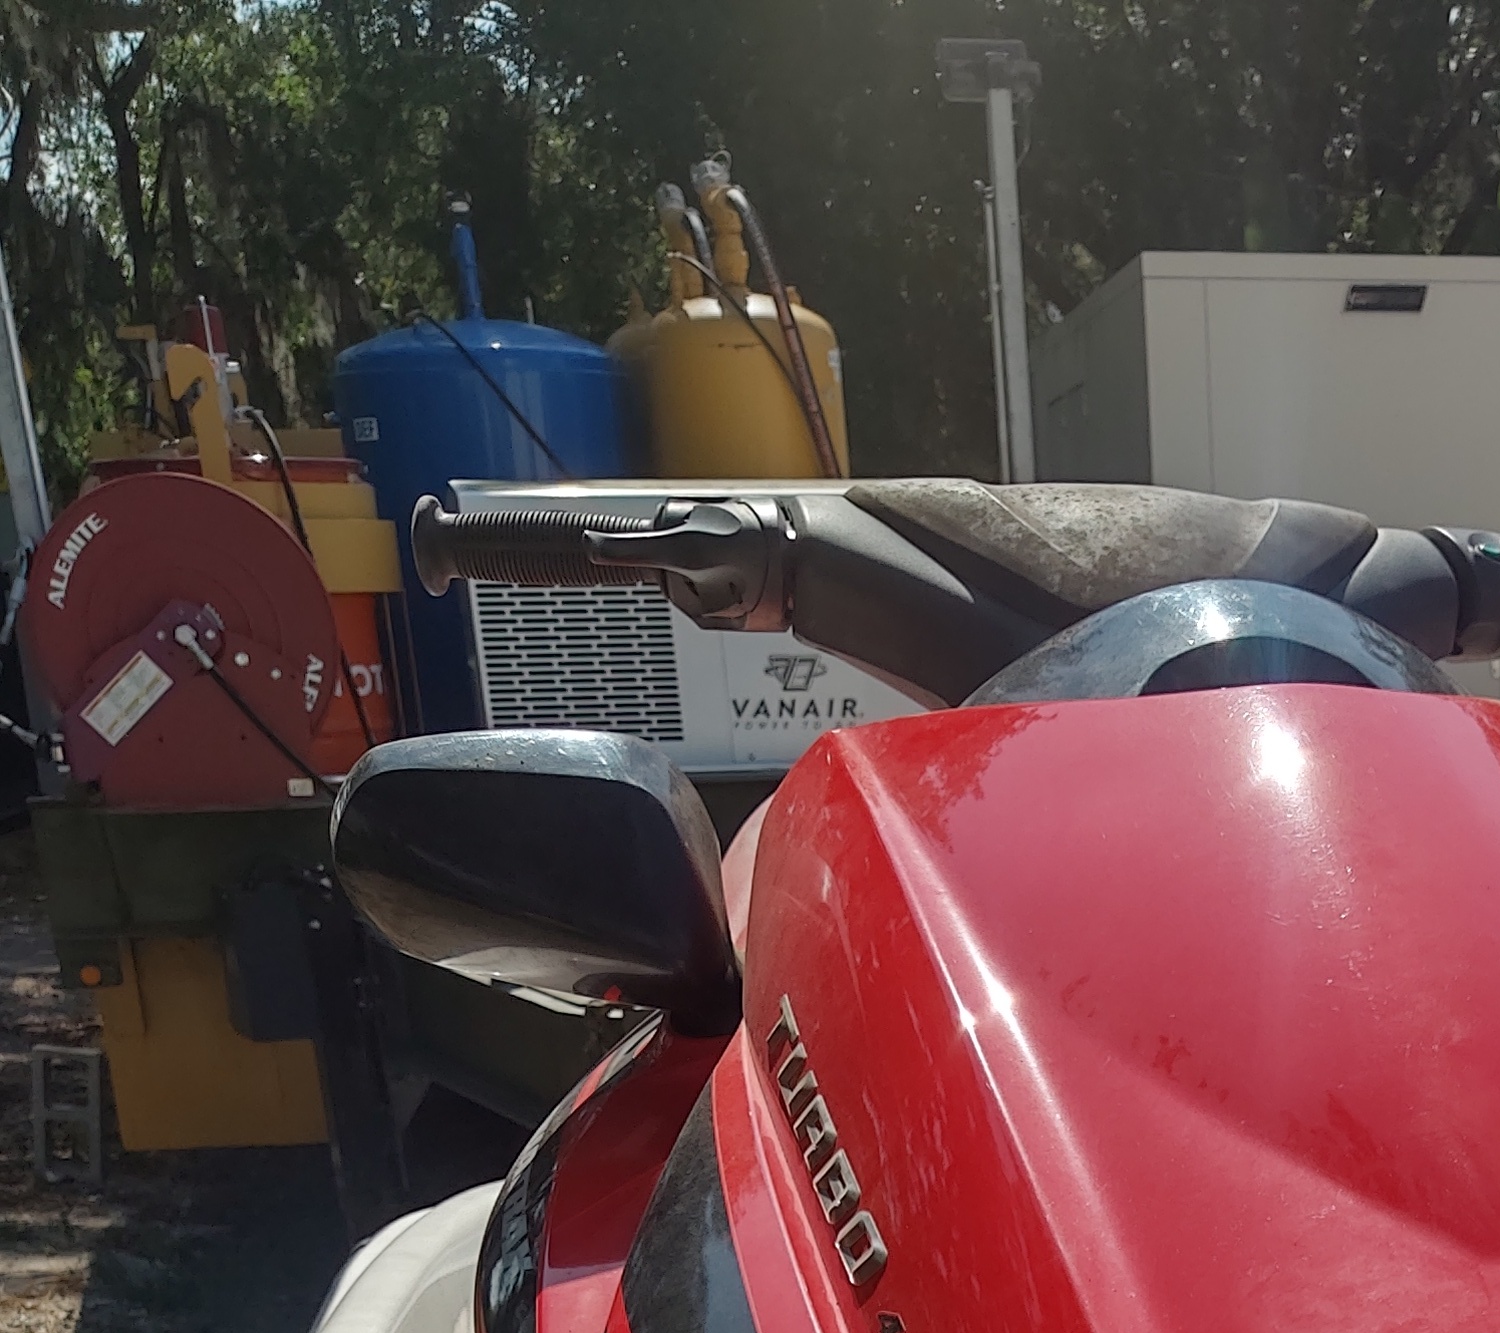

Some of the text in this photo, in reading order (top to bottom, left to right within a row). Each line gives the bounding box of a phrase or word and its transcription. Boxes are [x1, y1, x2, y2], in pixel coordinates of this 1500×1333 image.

[47, 512, 109, 610] ALEMITE
[732, 698, 857, 718] VANAIR
[767, 994, 888, 1287] TURBO
